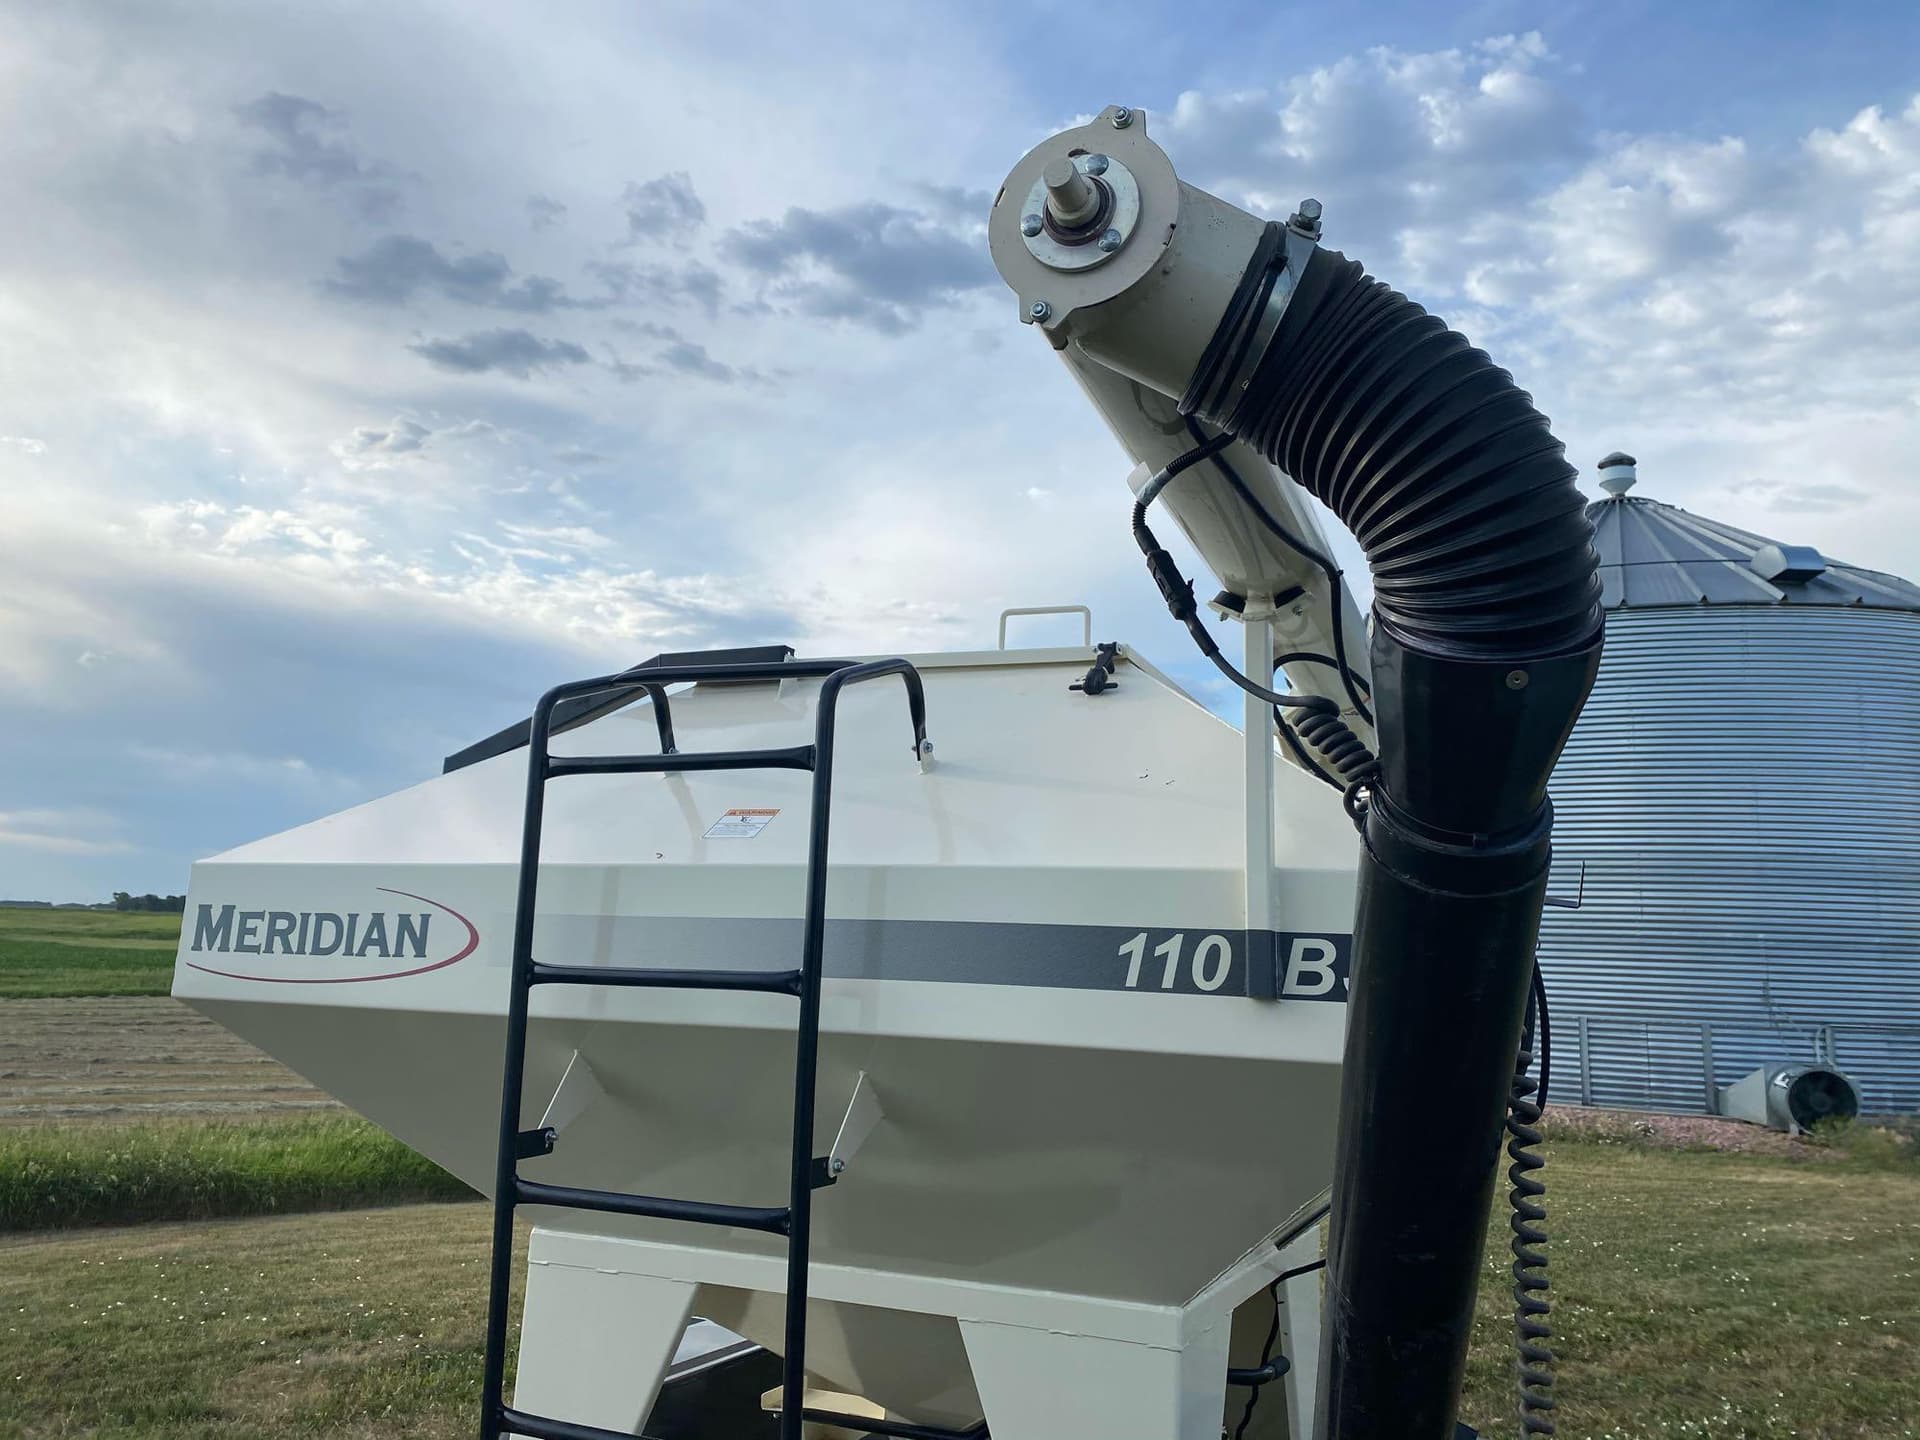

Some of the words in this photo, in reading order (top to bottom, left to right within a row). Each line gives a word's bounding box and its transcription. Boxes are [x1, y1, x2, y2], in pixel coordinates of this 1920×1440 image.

[191, 904, 432, 958] MERIDIAN
[1118, 932, 1232, 991] 110
[1282, 938, 1350, 996] B
